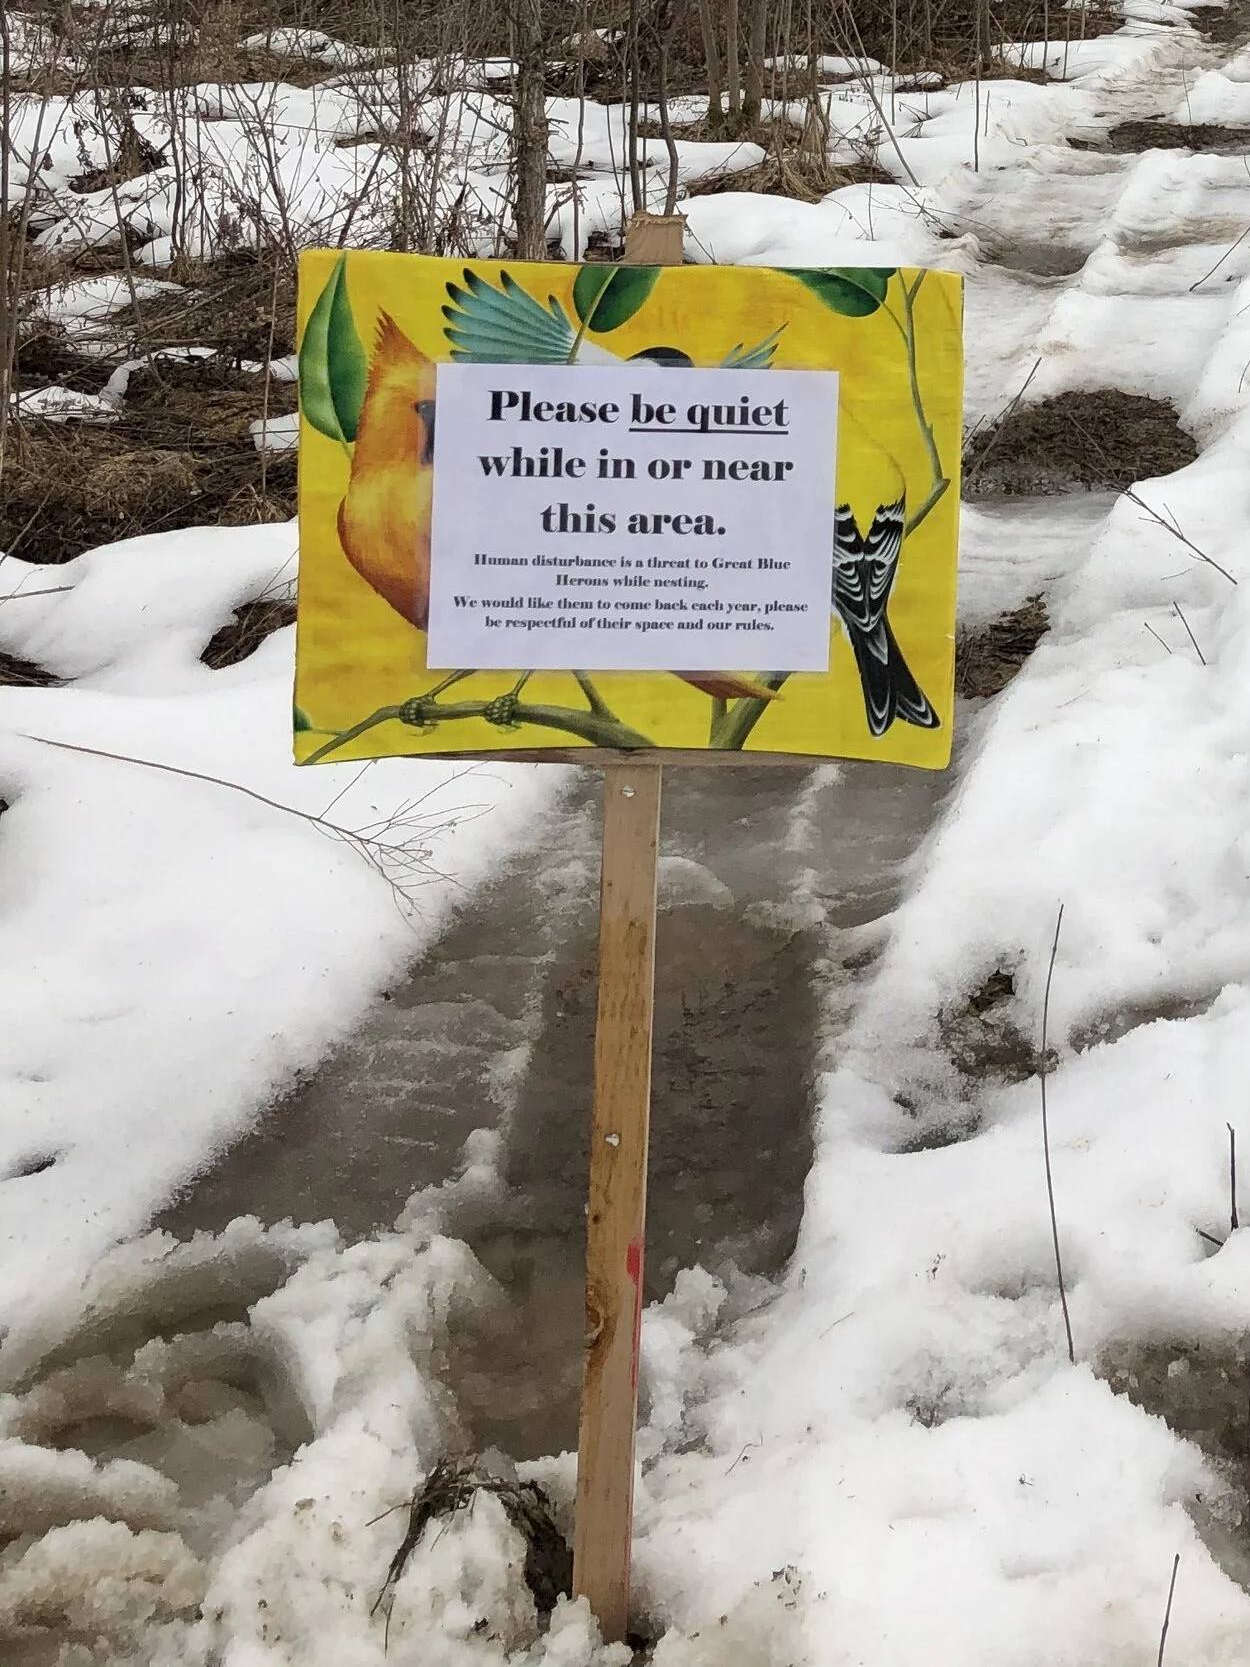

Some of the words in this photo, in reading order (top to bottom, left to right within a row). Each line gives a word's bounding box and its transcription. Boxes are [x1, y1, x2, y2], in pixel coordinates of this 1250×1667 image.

[486, 389, 620, 424] Please
[630, 393, 677, 426] be
[686, 395, 790, 435] quiet
[477, 446, 587, 479] while
[596, 448, 637, 479] in
[647, 459, 693, 480] or
[701, 459, 794, 482] near
[539, 502, 617, 534] this
[627, 513, 727, 536] area.
[473, 553, 529, 567] Human
[531, 554, 618, 568] disturbance
[619, 555, 633, 568] is
[634, 559, 644, 569] a
[646, 556, 691, 570] threat
[694, 558, 709, 569] to
[711, 557, 753, 570] Great
[756, 557, 792, 570] Blue
[555, 573, 609, 587] Herons
[612, 574, 651, 588] while
[653, 575, 709, 591] nesting.
[453, 595, 478, 609] We
[480, 596, 524, 609] would
[527, 596, 554, 609] like
[557, 597, 594, 610] them
[596, 598, 612, 610] to
[613, 601, 652, 611] come
[654, 598, 689, 611] back
[690, 599, 724, 612] each
[725, 602, 762, 615] year,
[764, 599, 809, 615] please
[484, 615, 503, 628] be
[504, 616, 577, 632] respectful
[579, 616, 597, 629] of
[597, 617, 632, 630] their
[634, 621, 675, 633] space
[676, 618, 704, 631] and
[706, 621, 733, 631] our
[735, 618, 775, 631] rules.
